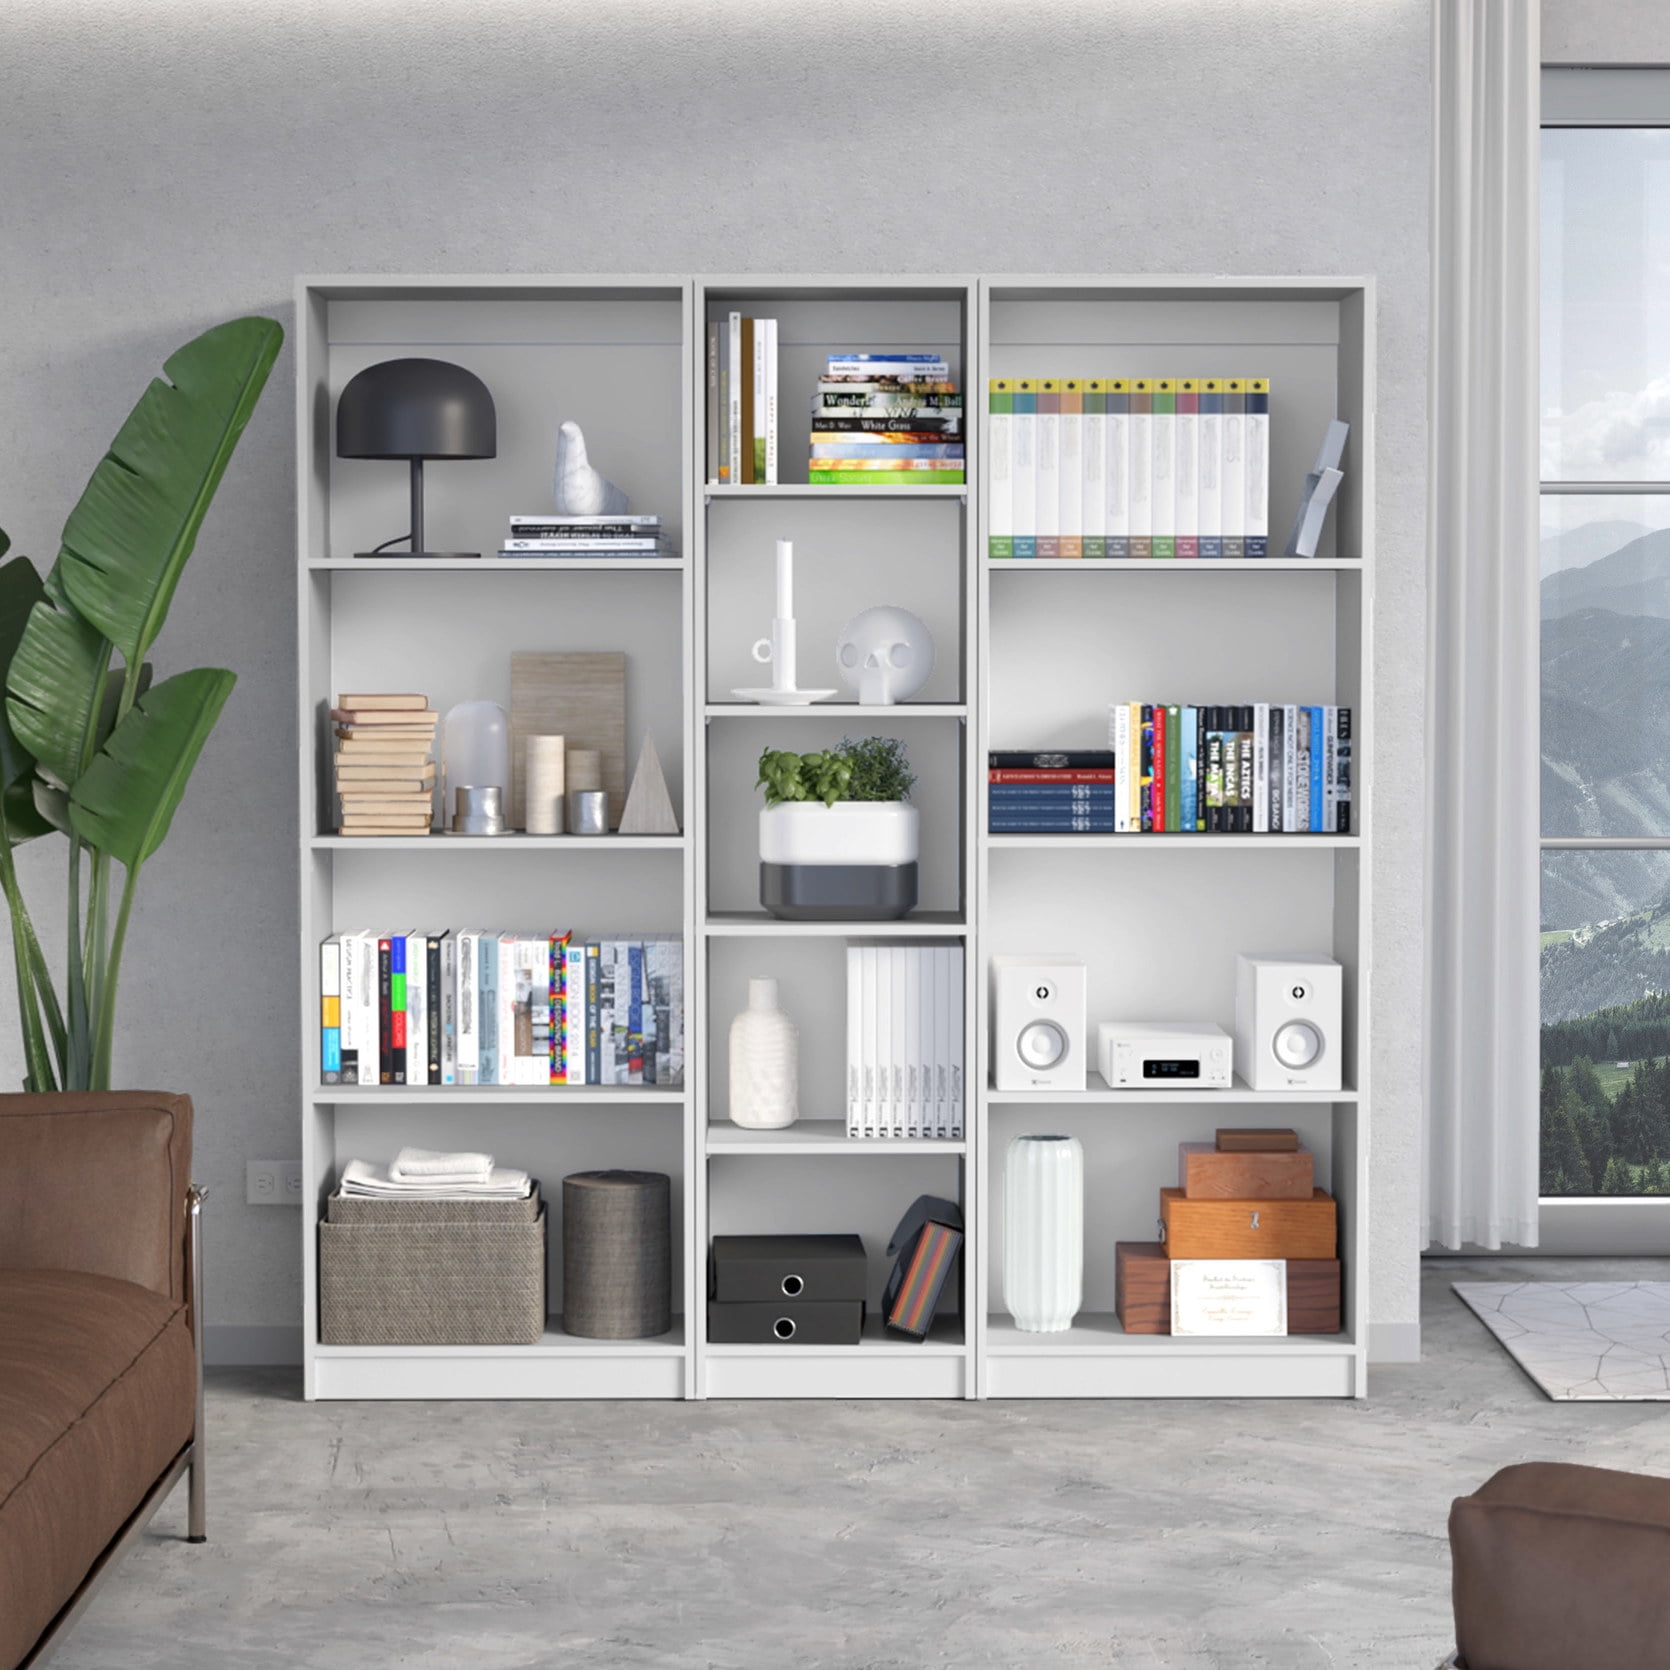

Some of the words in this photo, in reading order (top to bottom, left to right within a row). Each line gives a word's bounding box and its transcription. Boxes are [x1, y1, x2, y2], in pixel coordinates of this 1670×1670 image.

[860, 419, 886, 430] White
[888, 419, 912, 431] Grass
[1210, 741, 1219, 761] THE
[1226, 741, 1235, 761] THE
[1241, 739, 1250, 758] THE
[1326, 736, 1334, 785] GUNPOWDER
[1210, 763, 1219, 797] MAYA
[1226, 763, 1235, 797] INCAS
[1241, 760, 1250, 799] AZTECS
[1298, 750, 1309, 829] STONEWORKS
[554, 940, 562, 958] Todd
[554, 969, 562, 992] Banks
[571, 965, 580, 999] DESIGN
[571, 1002, 580, 1031] BOOK
[589, 1005, 596, 1013] OF
[571, 1033, 580, 1057] 2014
